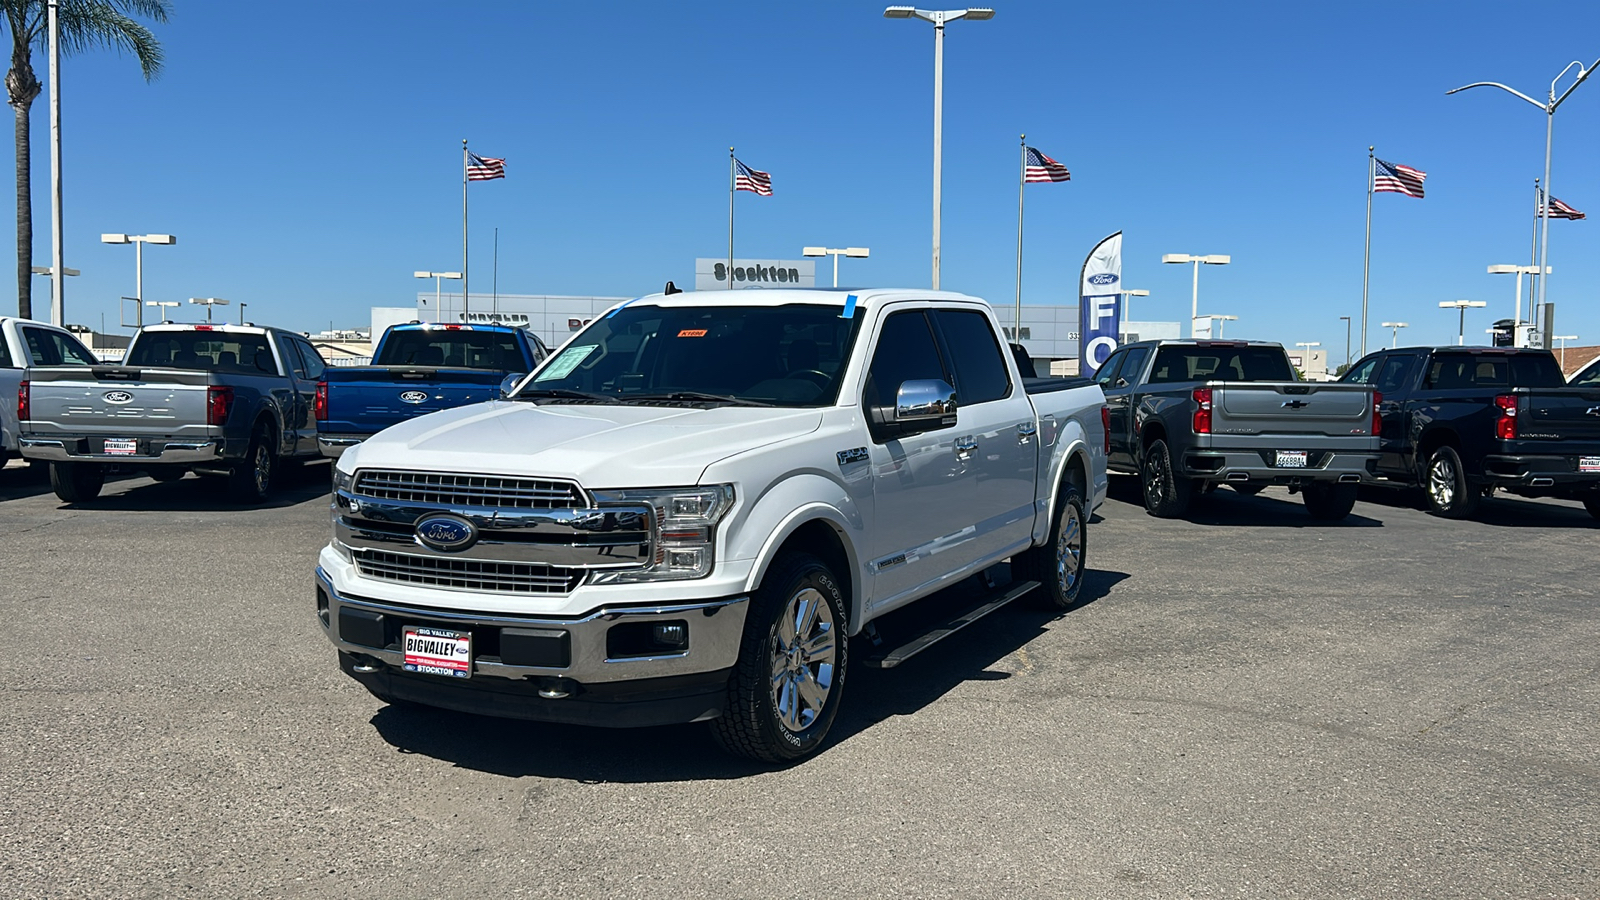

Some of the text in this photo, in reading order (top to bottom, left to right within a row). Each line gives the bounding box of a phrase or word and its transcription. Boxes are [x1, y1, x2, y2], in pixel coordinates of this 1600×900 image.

[714, 263, 799, 282] Stockton
[1093, 273, 1114, 284] Ford
[459, 313, 529, 322] CHRYSLER
[106, 391, 129, 401] Ford
[404, 391, 423, 400] Ford
[428, 523, 458, 540] Ford
[818, 575, 849, 686] GOODYEAR
[407, 638, 456, 656] BIGVALLEY
[417, 665, 454, 675] STOCKTON
